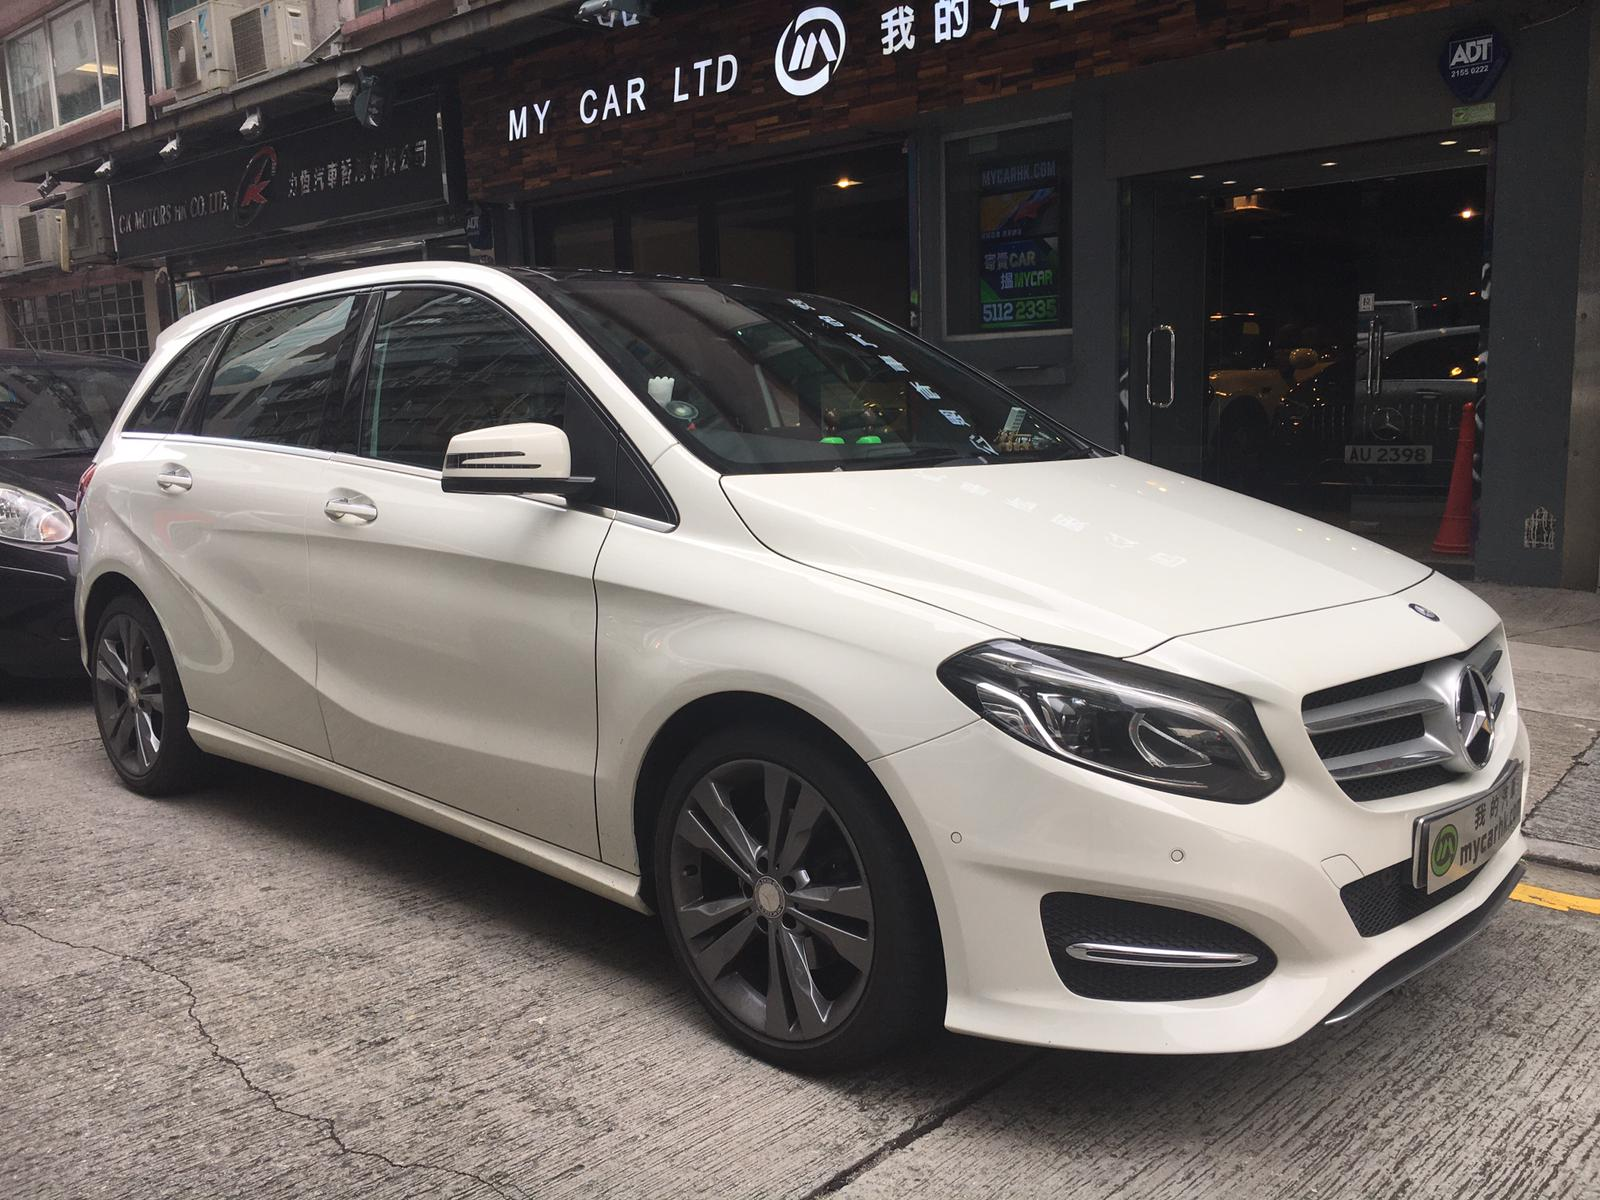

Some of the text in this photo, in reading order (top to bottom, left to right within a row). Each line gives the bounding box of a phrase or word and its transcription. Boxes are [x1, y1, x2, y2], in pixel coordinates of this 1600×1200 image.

[880, 0, 1088, 54] 我的汽
[1450, 38, 1493, 66] ADT
[1451, 65, 1488, 78] 2155 0222
[508, 54, 738, 142] MY CAR LTD
[134, 204, 172, 231] MOTORS
[982, 299, 1057, 322] 5112 2335
[1350, 448, 1426, 462] AU 2398
